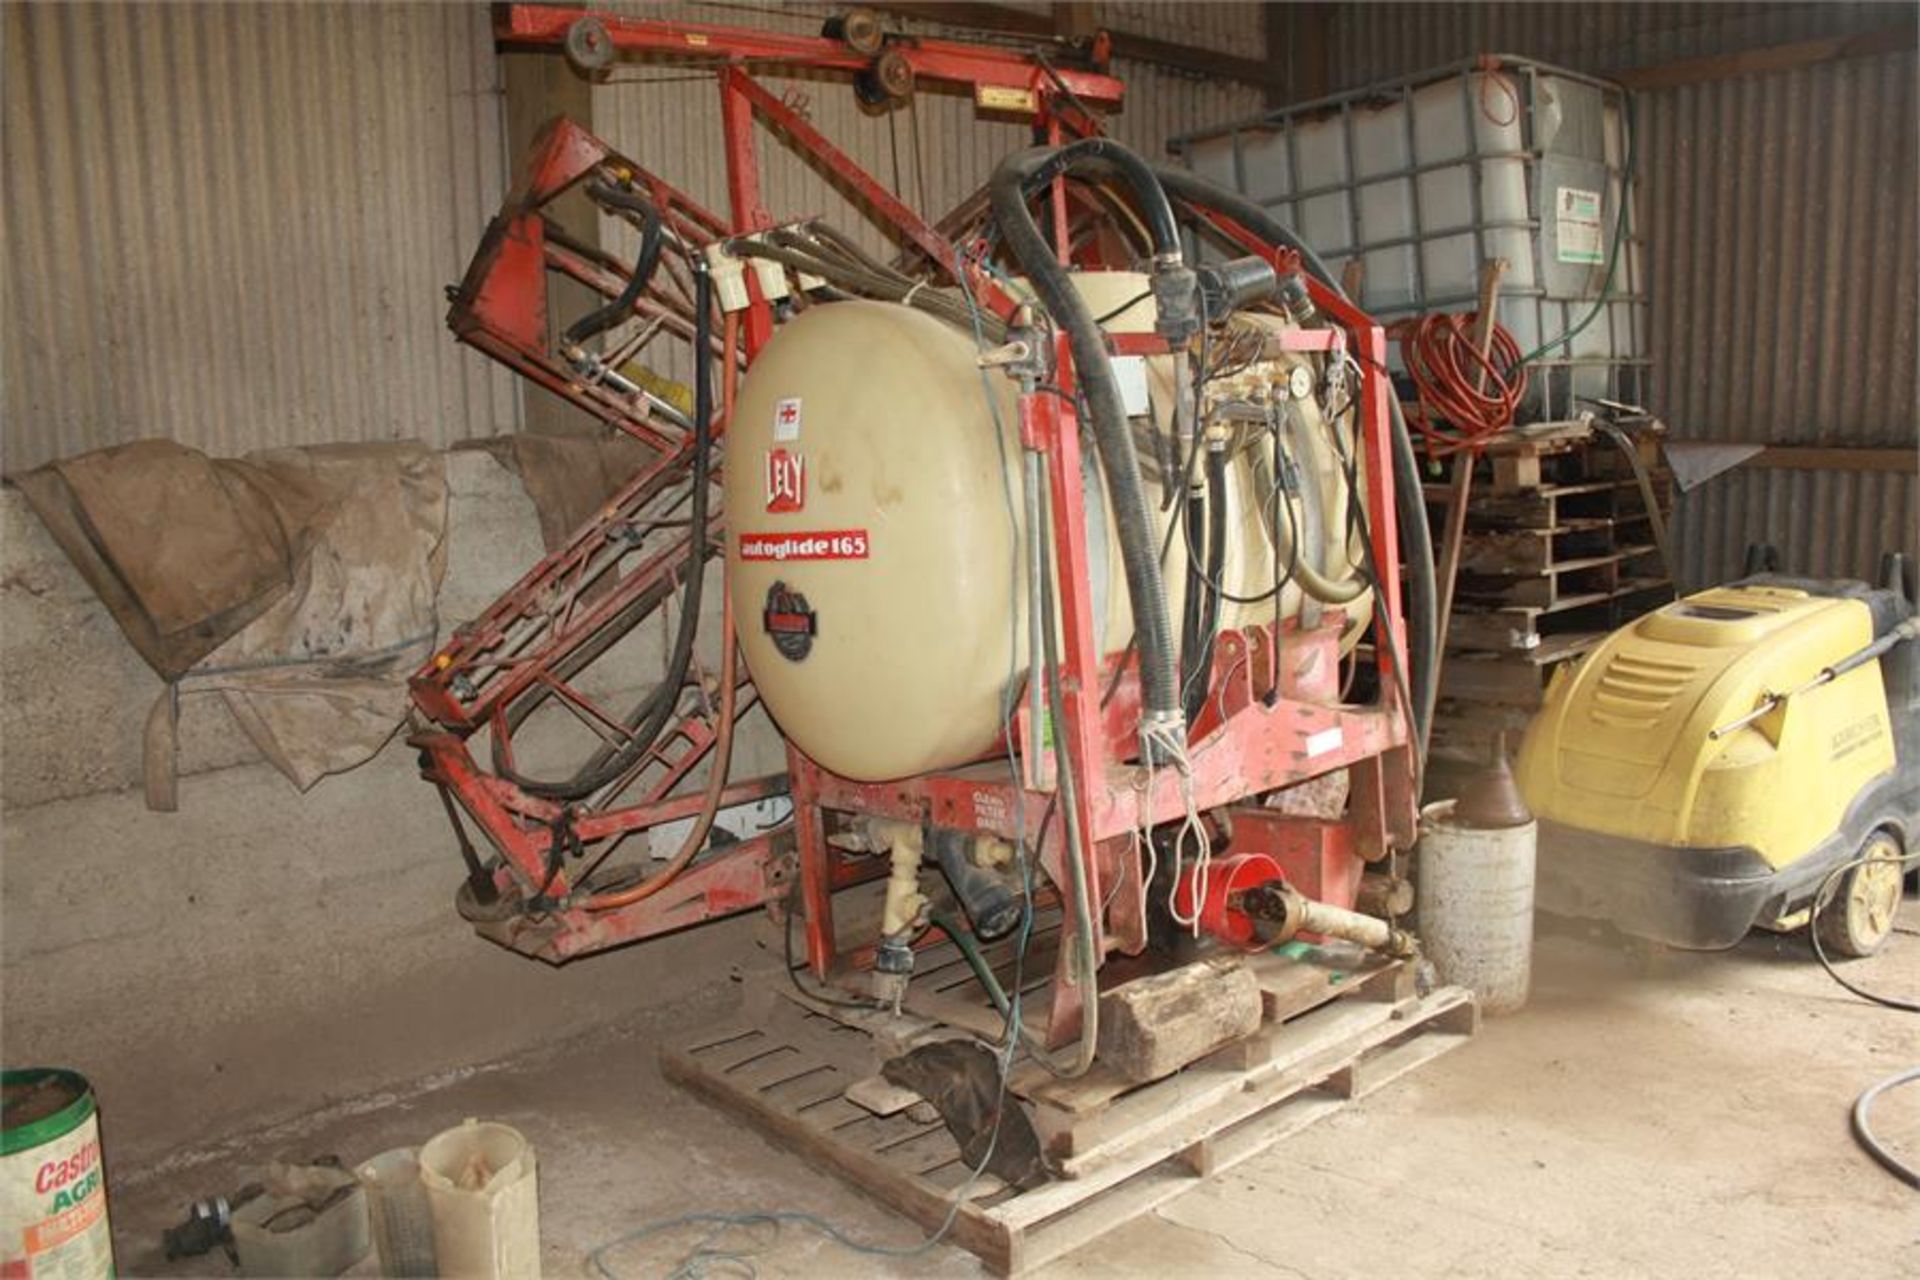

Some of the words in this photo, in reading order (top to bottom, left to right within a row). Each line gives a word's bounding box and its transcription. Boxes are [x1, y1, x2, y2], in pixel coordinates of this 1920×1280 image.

[766, 451, 803, 505] LELY
[741, 538, 828, 560] autoglide
[831, 536, 866, 555] 165
